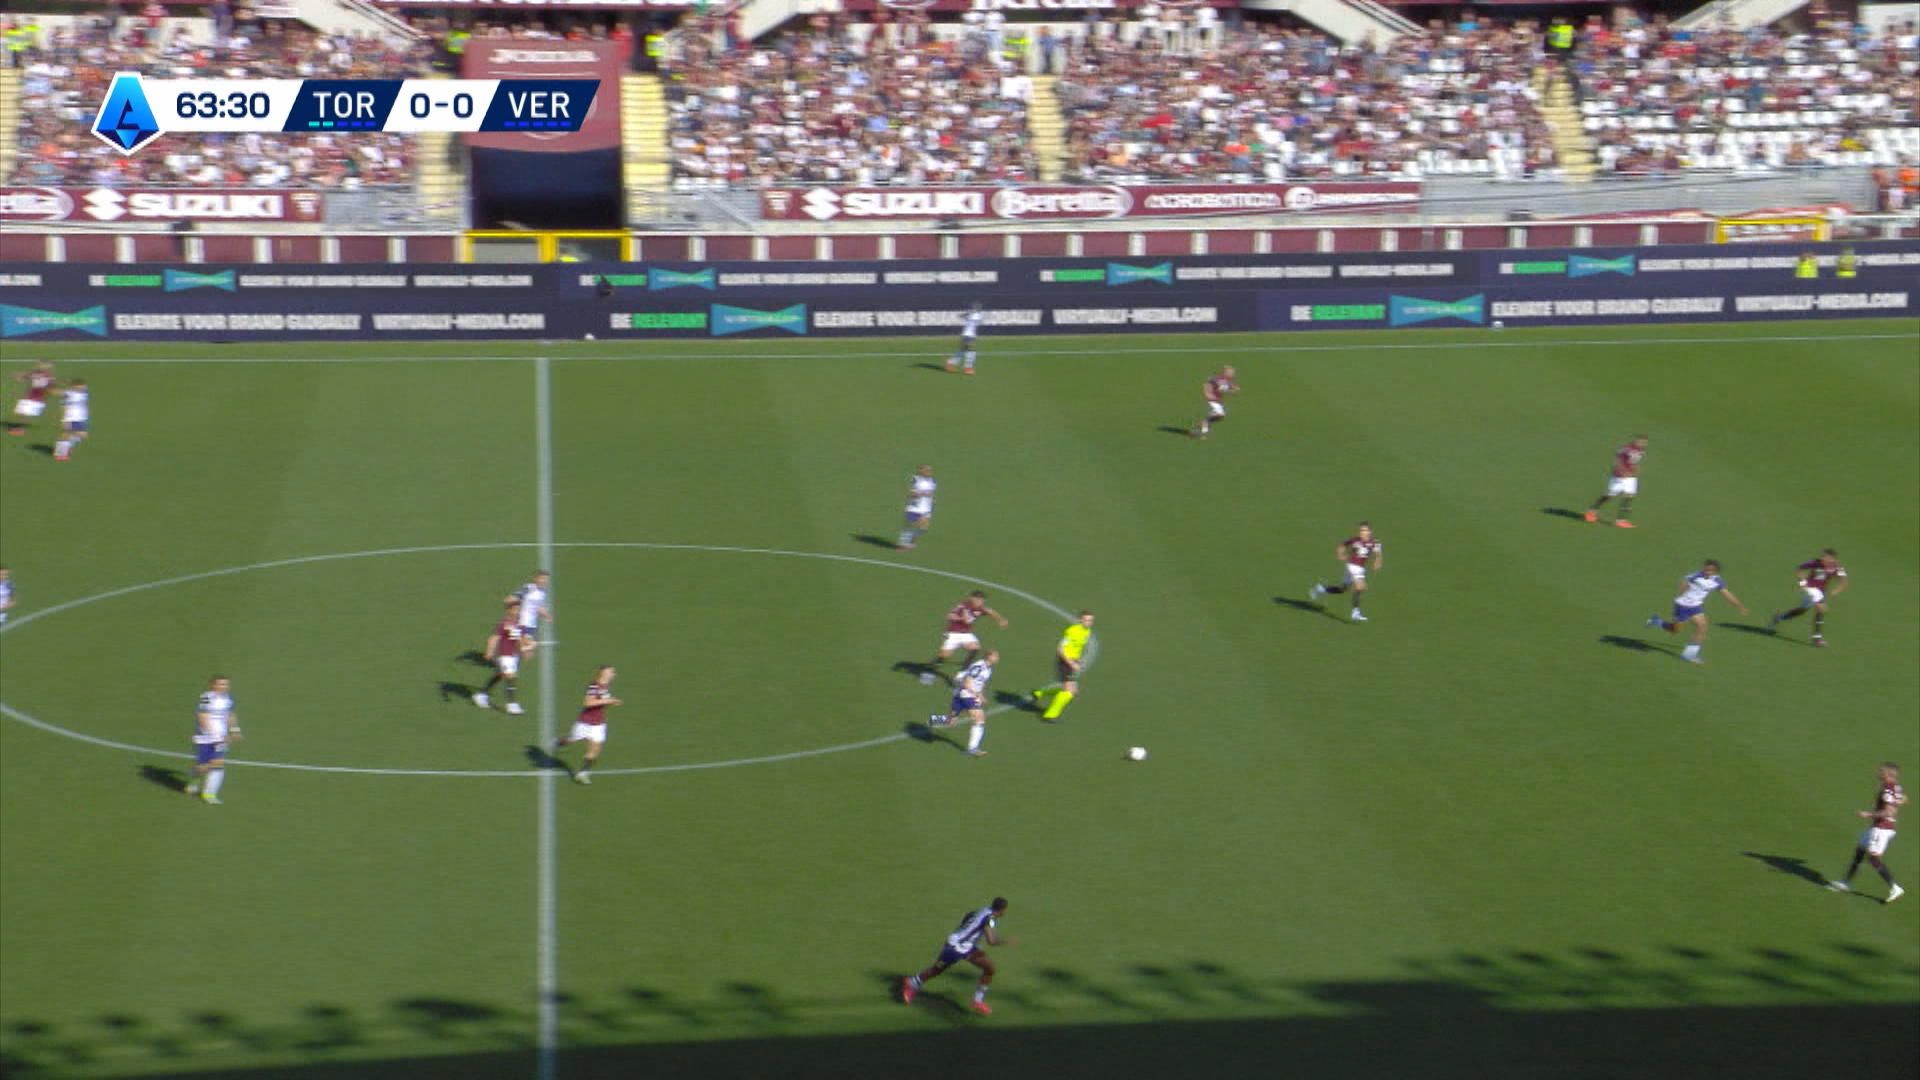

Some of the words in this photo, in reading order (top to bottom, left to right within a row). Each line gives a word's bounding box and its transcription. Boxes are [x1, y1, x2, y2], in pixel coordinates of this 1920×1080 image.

[128, 192, 284, 218] SUZUKI
[842, 191, 985, 215] SUZUKI
[609, 313, 632, 329] BE
[1290, 305, 1312, 321] BE
